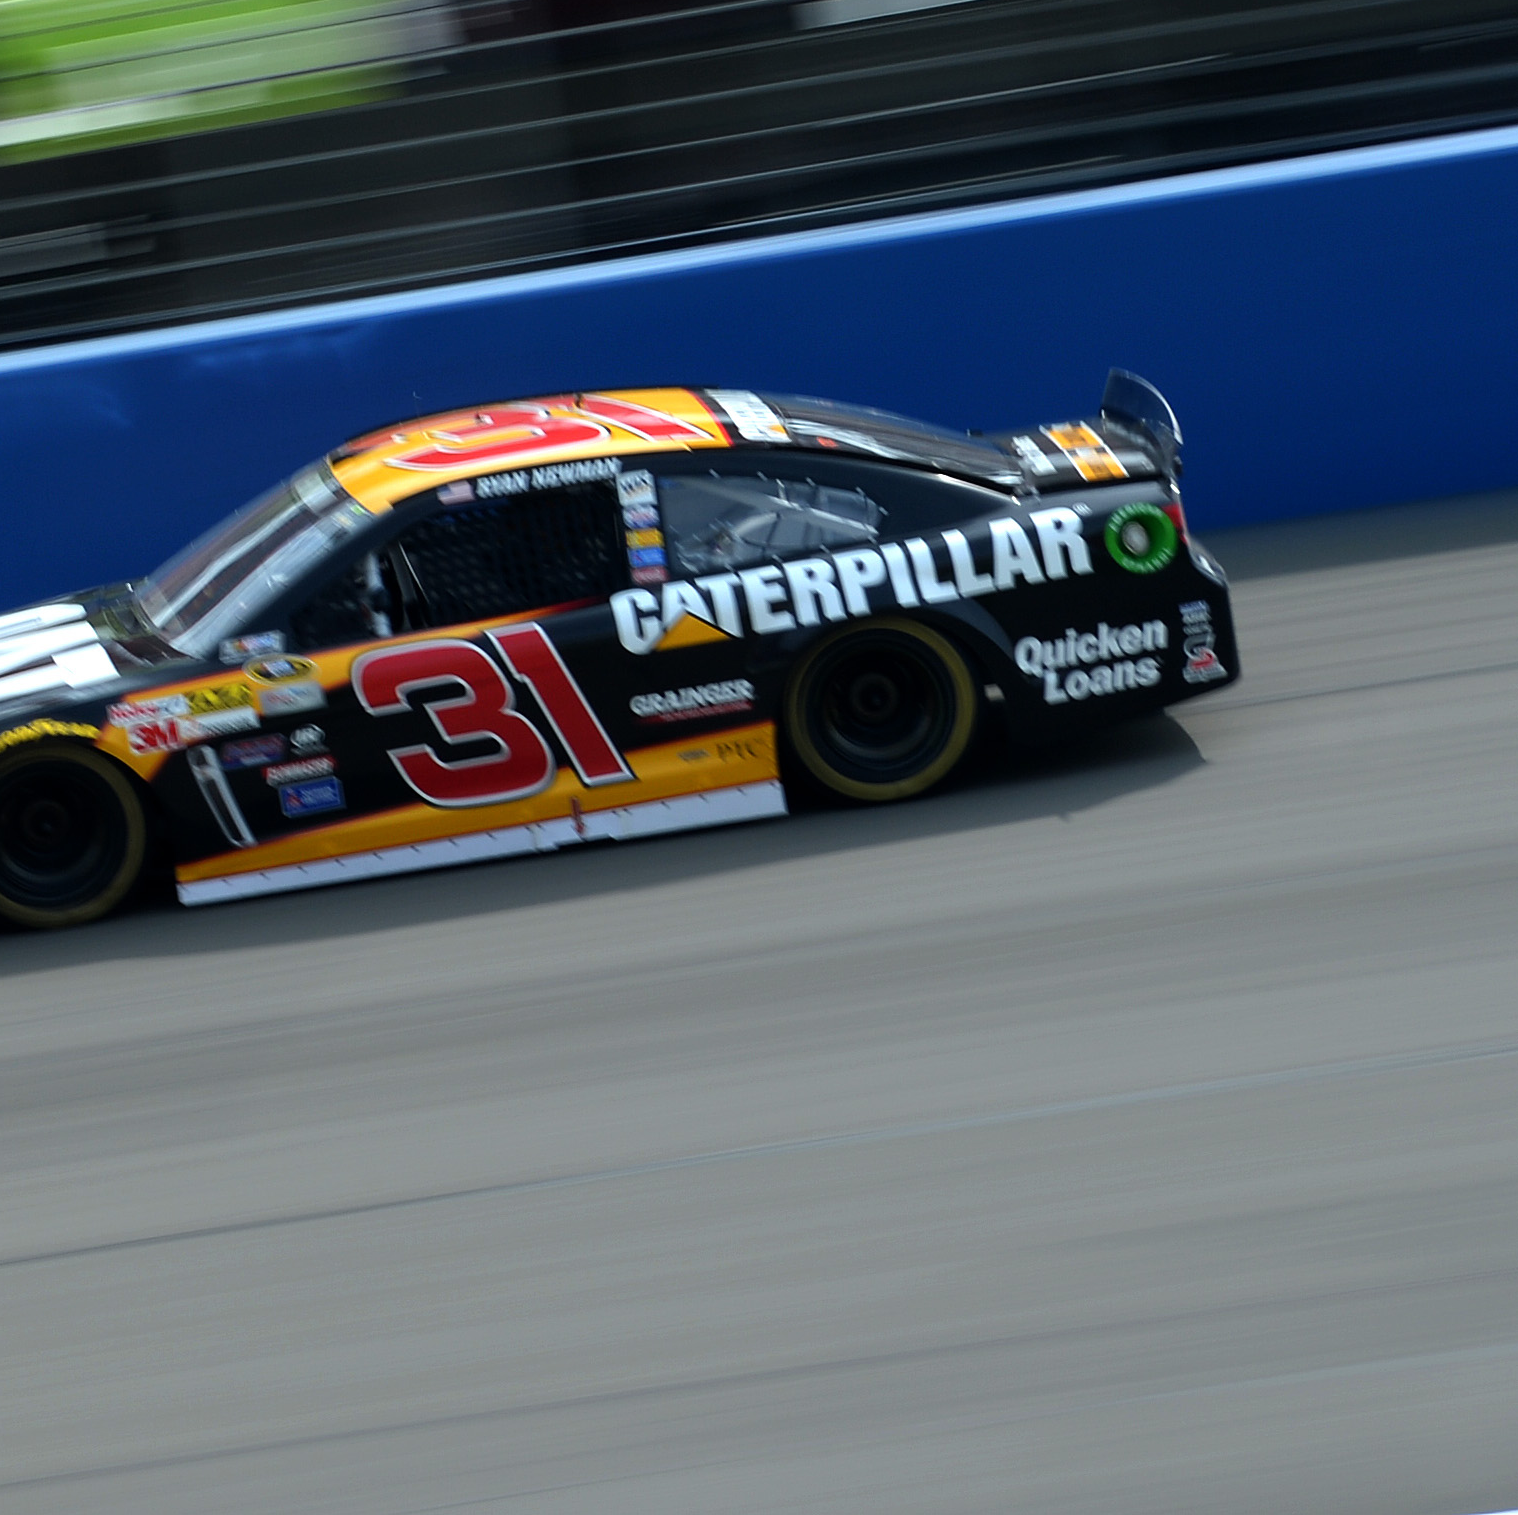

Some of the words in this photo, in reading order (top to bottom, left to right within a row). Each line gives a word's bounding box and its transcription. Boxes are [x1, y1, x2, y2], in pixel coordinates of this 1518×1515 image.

[531, 456, 623, 490] NEWMAN
[610, 506, 1094, 655] CATERPILLAR
[1015, 619, 1169, 678] Quicken
[629, 677, 756, 718] GRAINGER
[1043, 656, 1162, 705] Loans
[350, 620, 639, 807] 31
